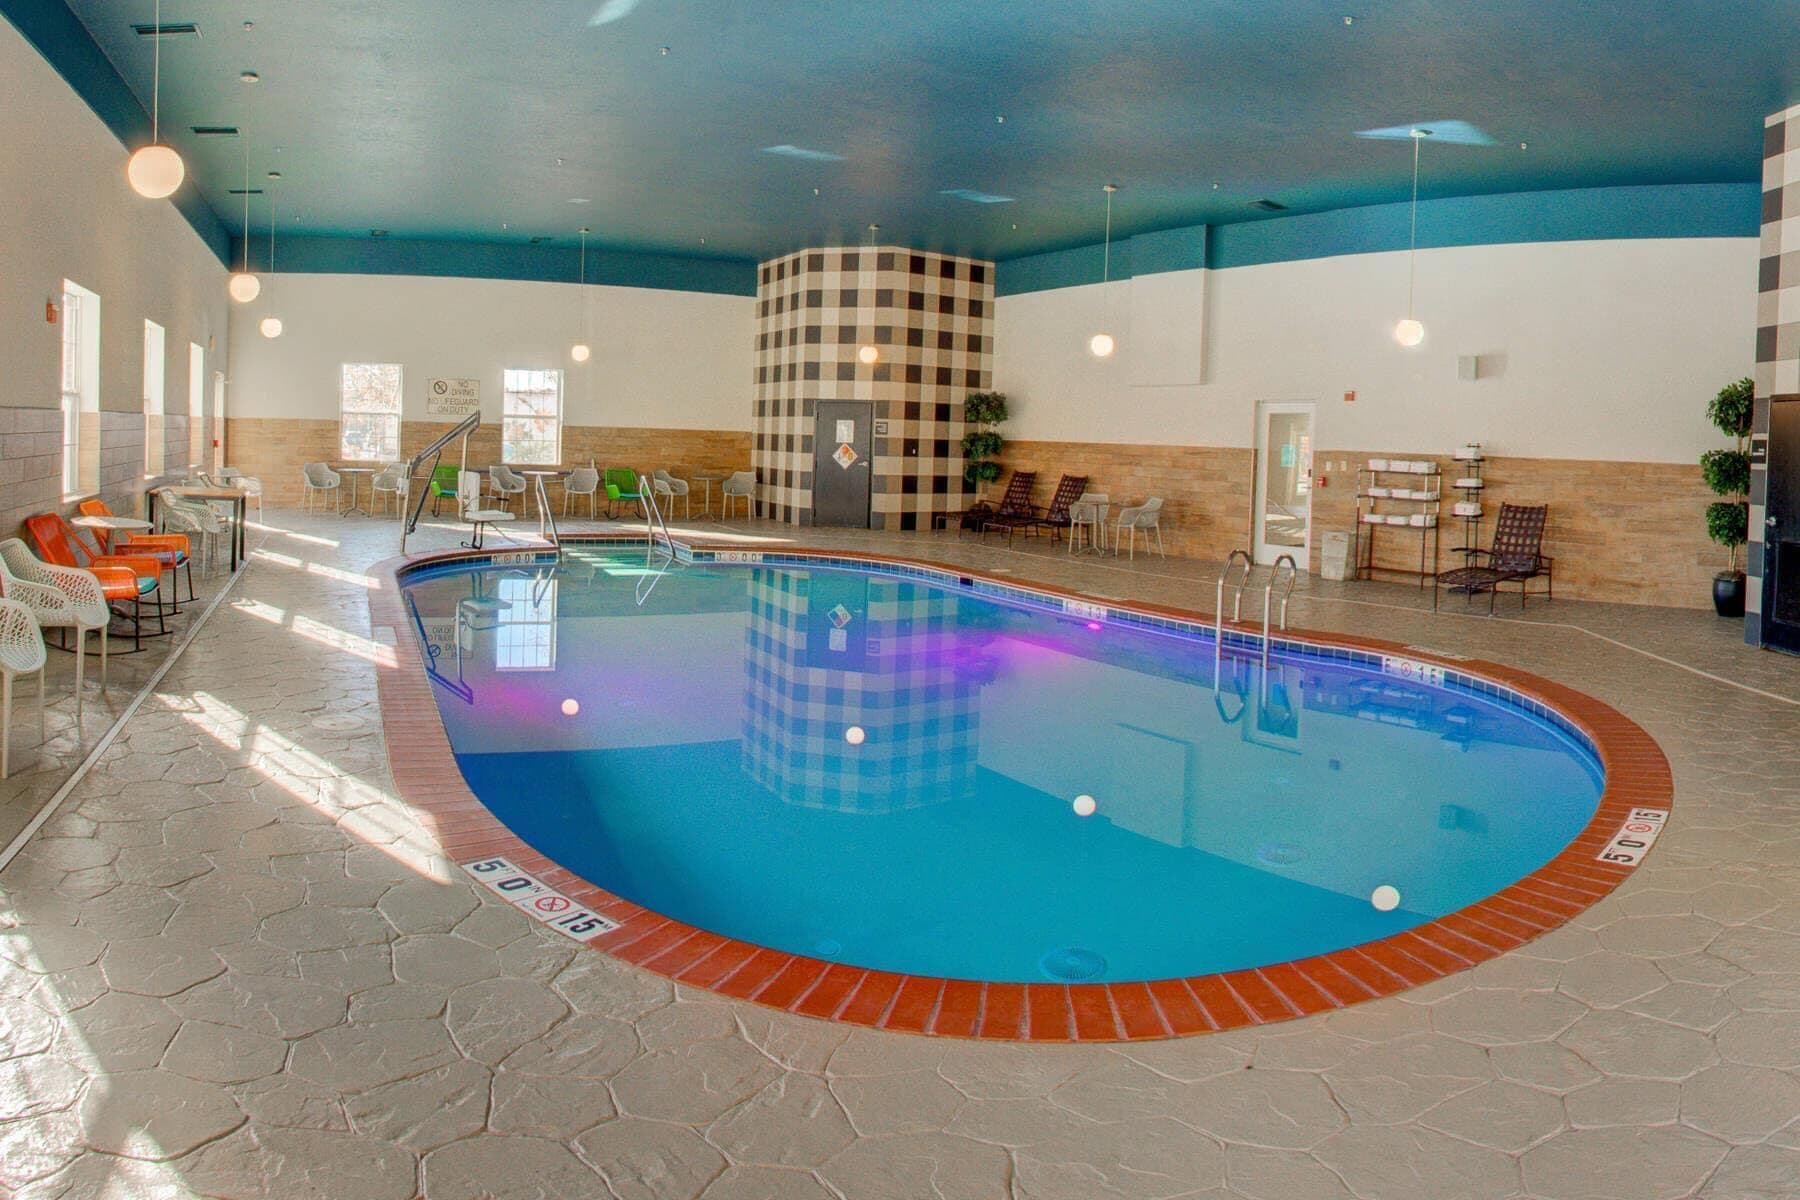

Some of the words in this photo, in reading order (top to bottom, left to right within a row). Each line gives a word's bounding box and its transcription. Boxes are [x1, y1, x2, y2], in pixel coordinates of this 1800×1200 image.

[1603, 852, 1634, 862] 5
[473, 859, 507, 872] 5
[497, 877, 532, 891] 0
